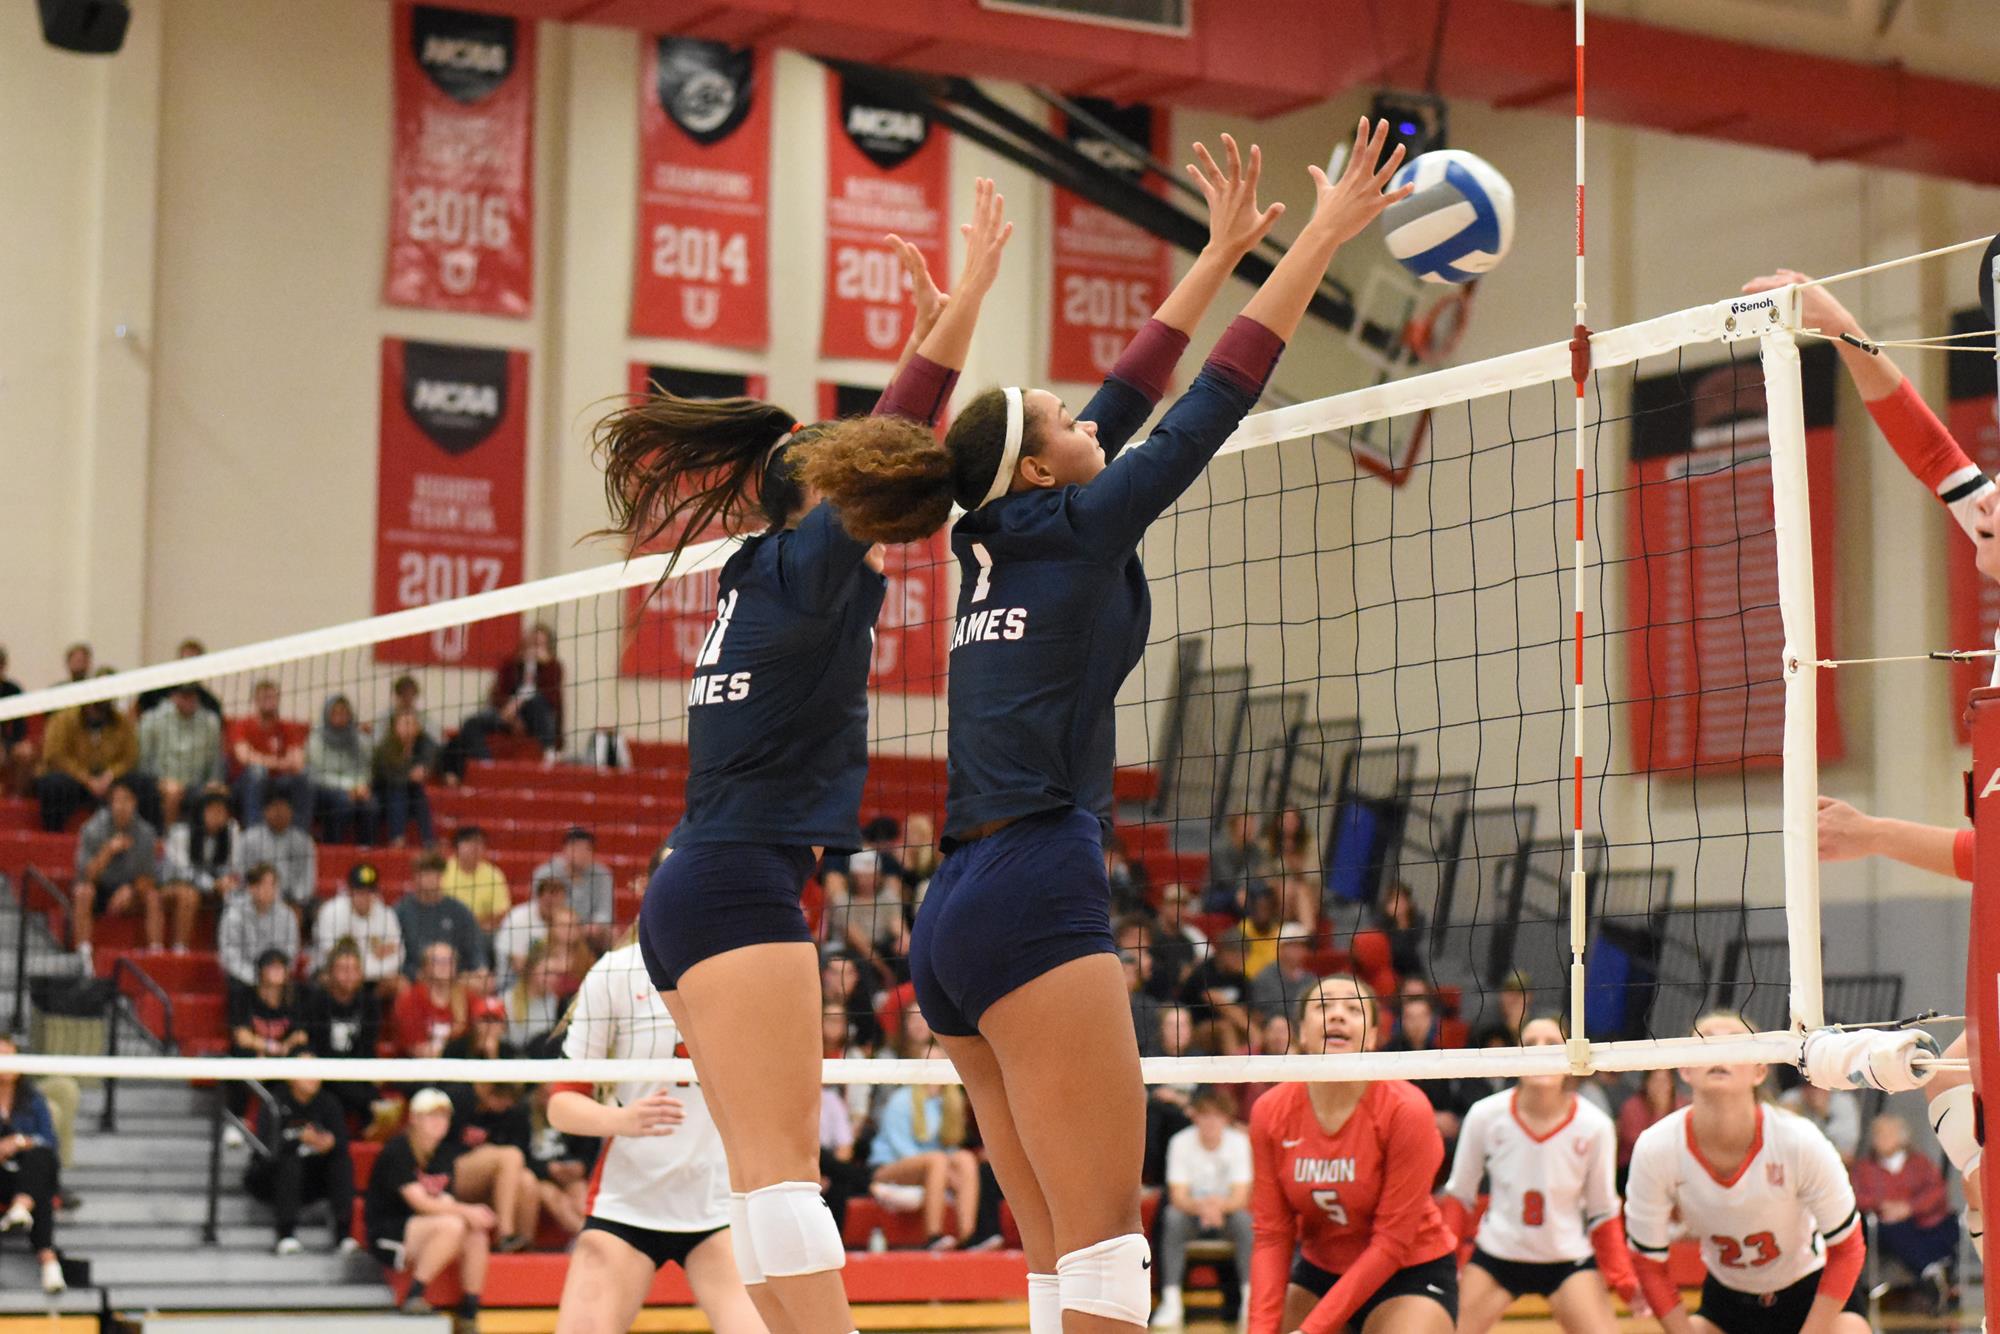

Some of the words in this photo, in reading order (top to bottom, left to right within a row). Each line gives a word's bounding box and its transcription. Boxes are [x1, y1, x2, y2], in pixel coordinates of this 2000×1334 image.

[408, 186, 511, 250] 2016
[652, 224, 748, 285] 2014
[680, 287, 720, 330] U
[1063, 275, 1154, 329] 2015
[1740, 298, 1774, 313] Senoh
[864, 308, 899, 349] U
[397, 549, 505, 606] 2017
[971, 543, 993, 603] 1
[950, 608, 1028, 652] AMES
[1294, 1158, 1355, 1183] UNION
[1311, 1190, 1349, 1226] 5
[1710, 1231, 1781, 1270] 23
